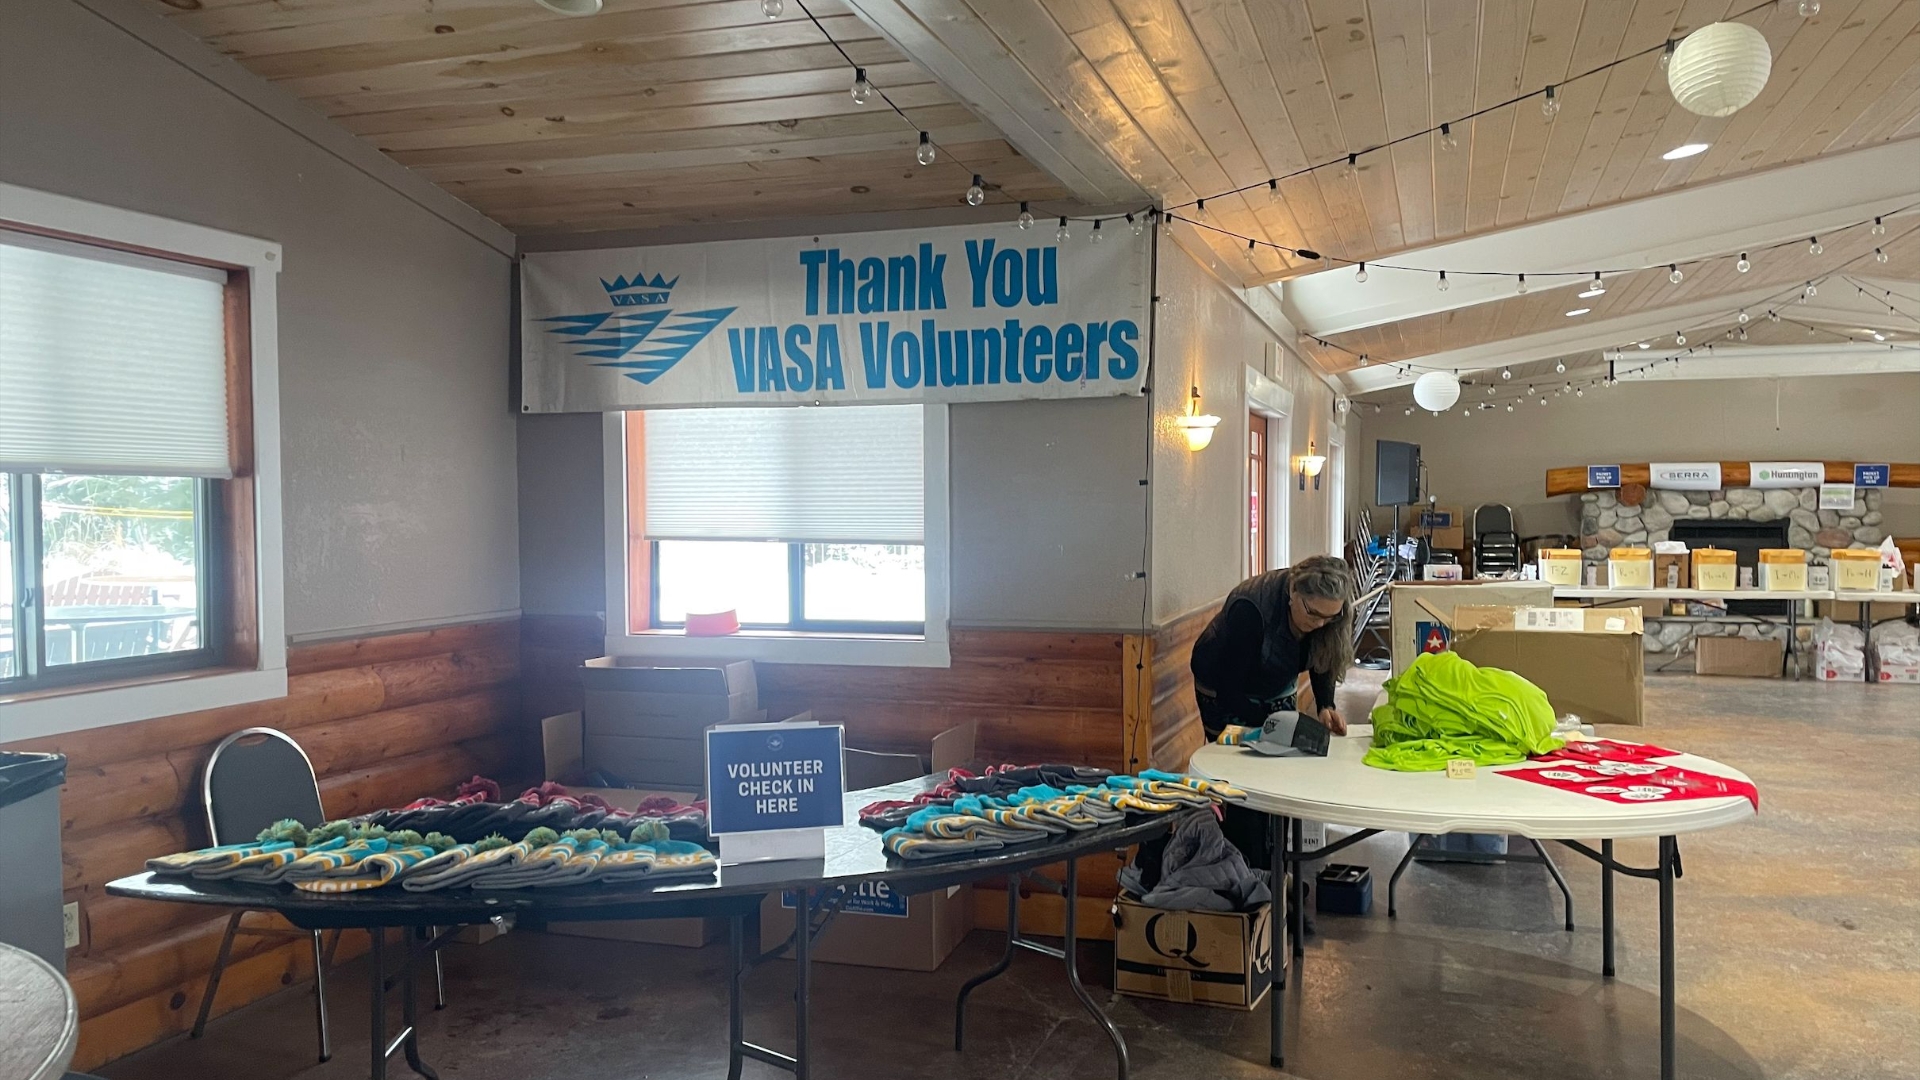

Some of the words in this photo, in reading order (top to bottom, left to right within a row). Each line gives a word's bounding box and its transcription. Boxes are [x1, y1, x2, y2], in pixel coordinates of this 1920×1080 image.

[800, 243, 947, 315] Thank
[965, 239, 1058, 308] You
[613, 293, 666, 305] VASA
[728, 325, 845, 393] VASA
[860, 319, 1139, 389] Volunteers
[1771, 470, 1818, 481] Huntington
[727, 760, 824, 779] VOLUNTEER
[738, 780, 793, 796] CHECK
[797, 779, 814, 793] IN
[756, 798, 798, 814] HERE
[1145, 912, 1211, 968] Q
